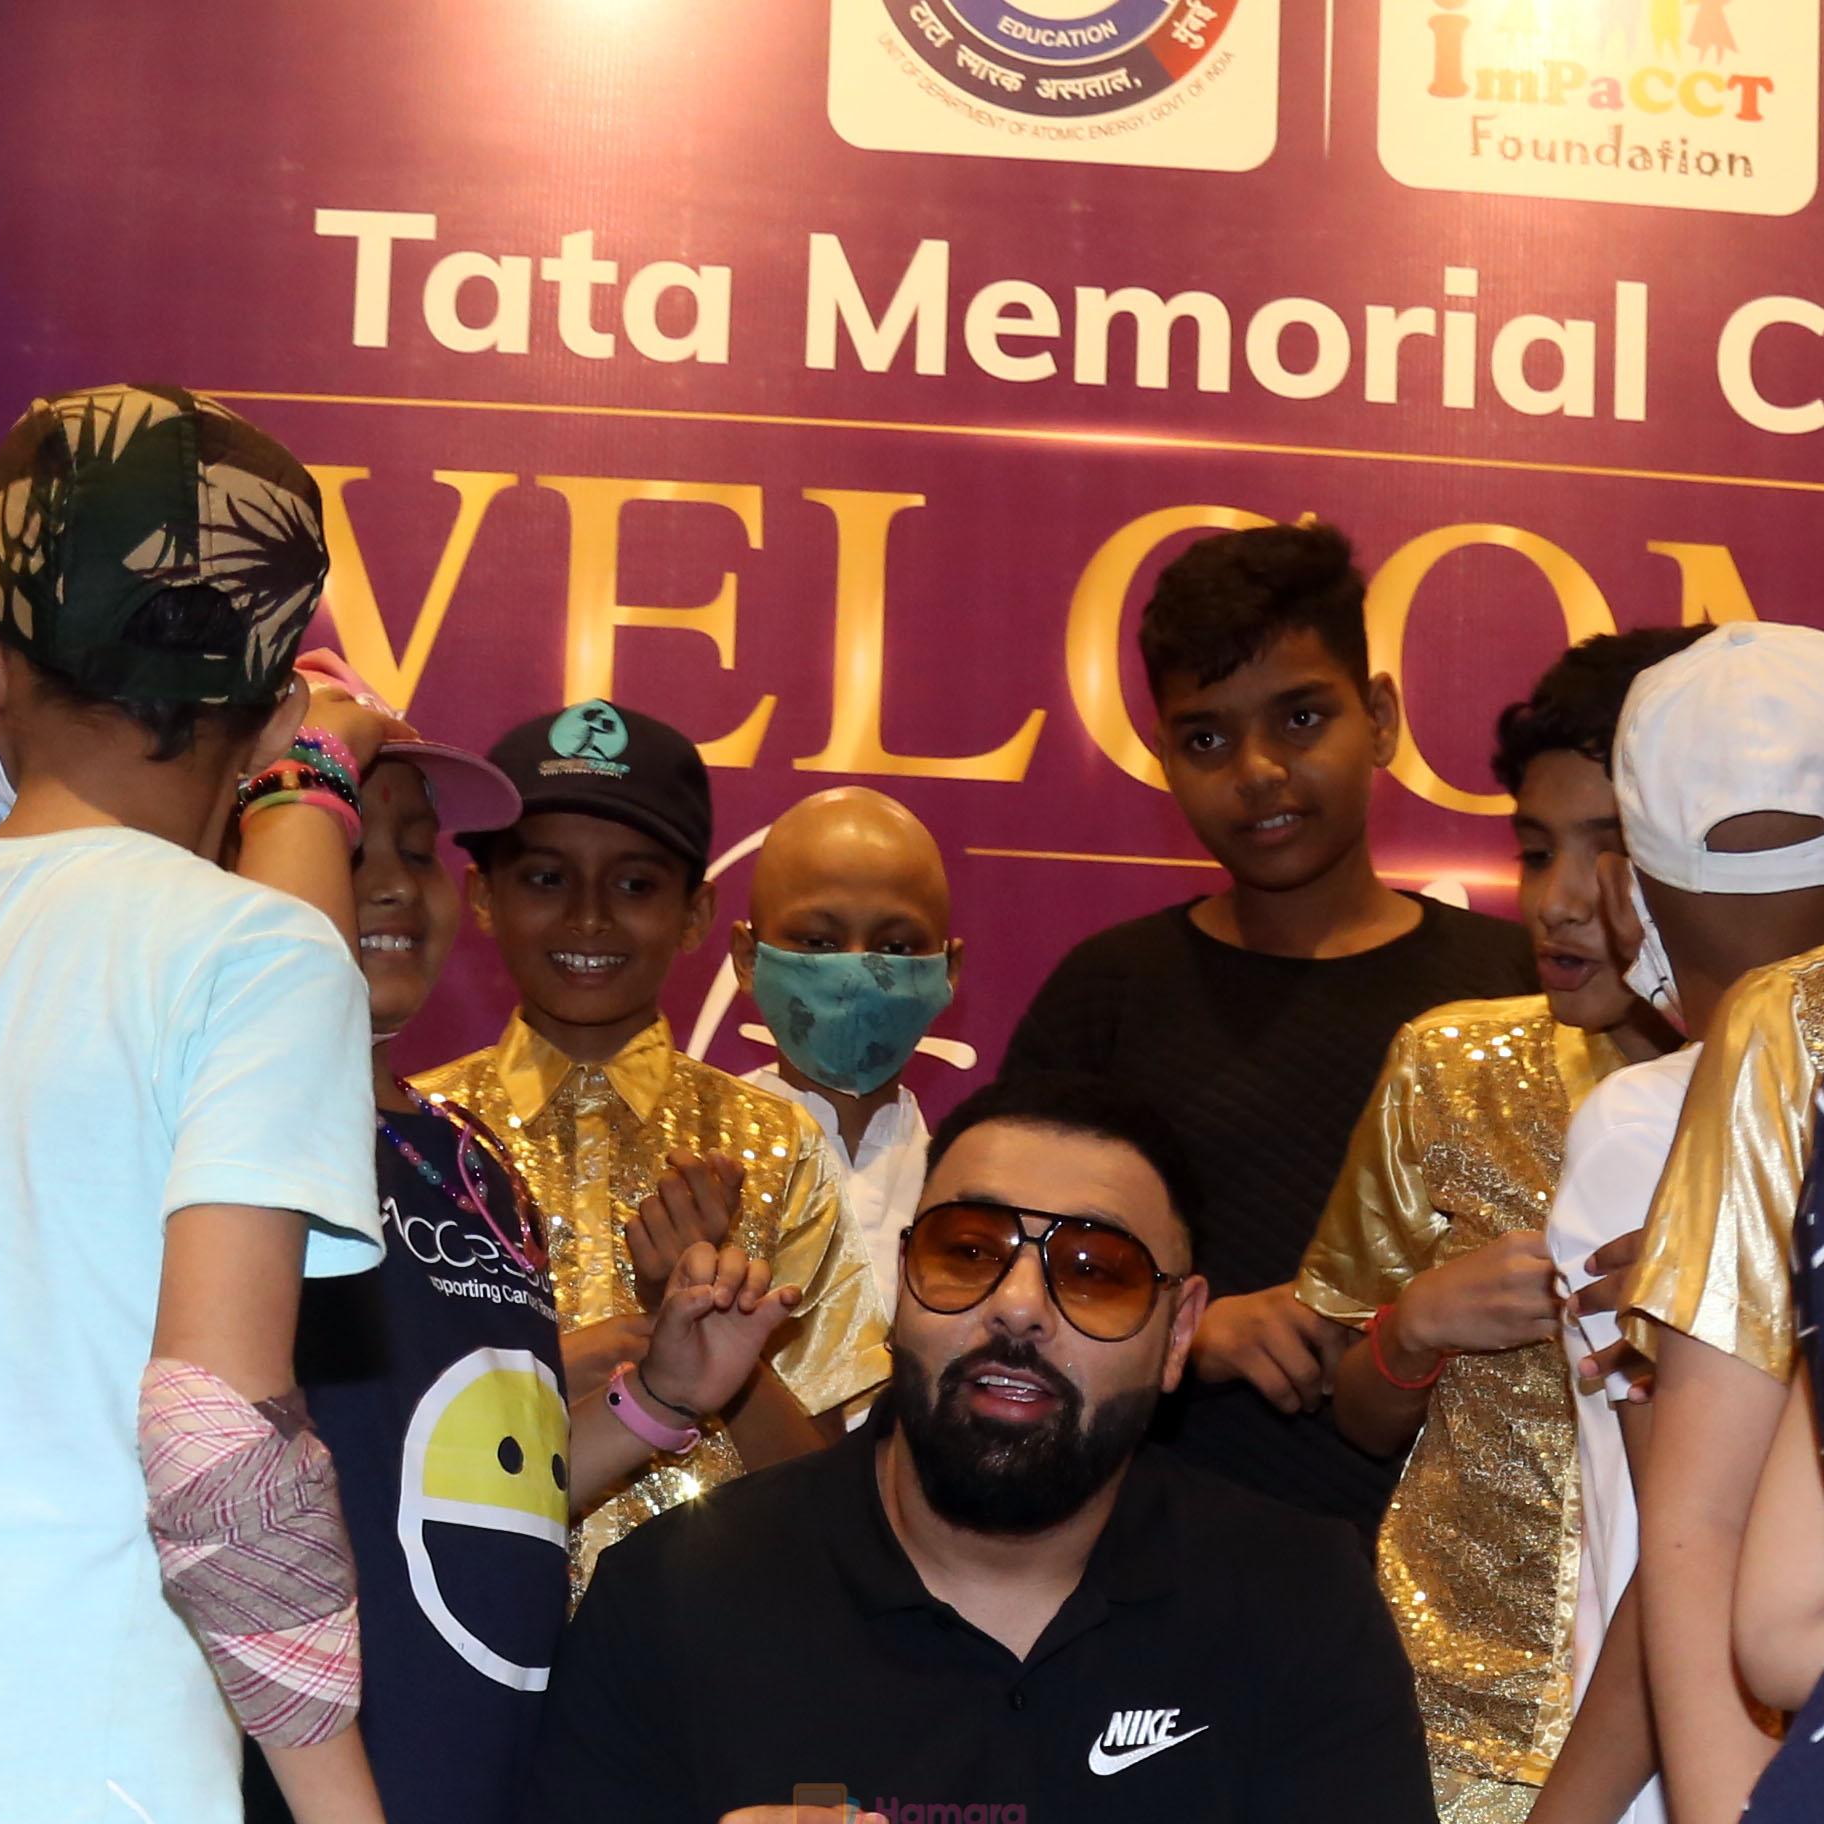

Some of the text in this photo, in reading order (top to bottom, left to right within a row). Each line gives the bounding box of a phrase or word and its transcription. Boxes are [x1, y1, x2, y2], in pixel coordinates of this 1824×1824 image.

[996, 15, 1119, 48] EDUCATION
[1007, 120, 1028, 136] OF
[1031, 124, 1085, 141] ATOMIC
[1469, 114, 1755, 178] Foundation
[314, 208, 733, 365] Tata
[804, 231, 1648, 422] Memorial
[1103, 1708, 1181, 1748] NIKE
